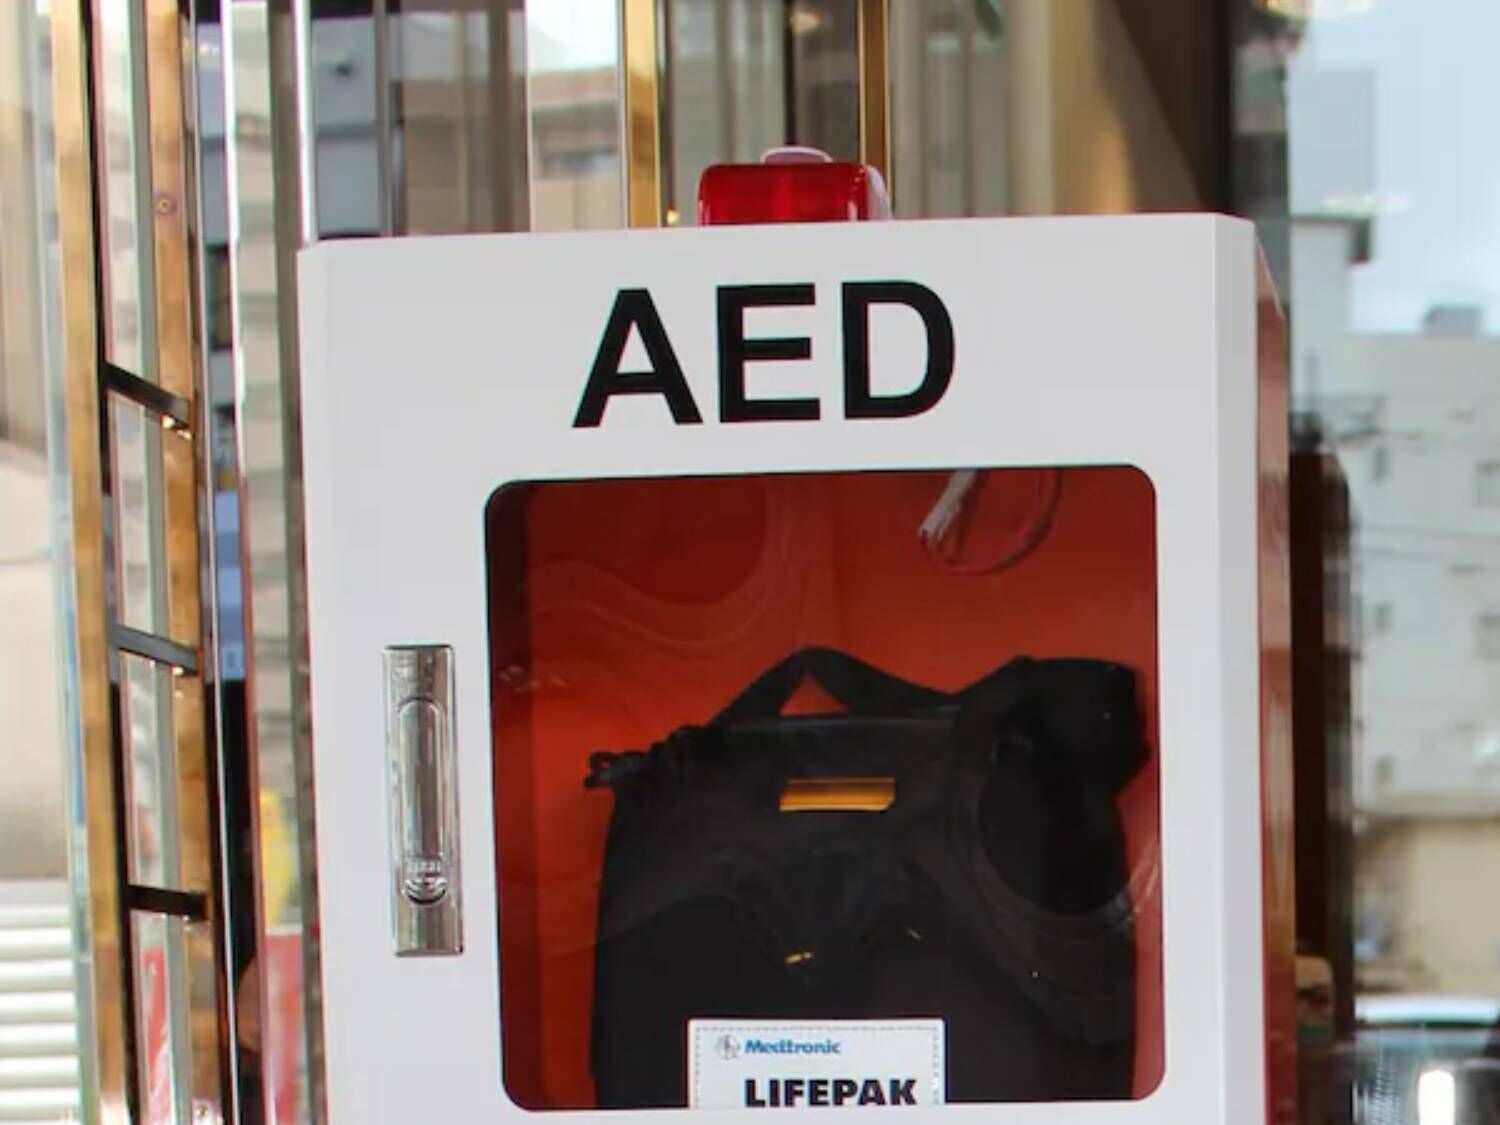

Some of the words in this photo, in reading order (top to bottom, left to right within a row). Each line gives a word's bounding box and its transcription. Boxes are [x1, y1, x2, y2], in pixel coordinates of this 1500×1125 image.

[572, 280, 955, 427] AED
[743, 1039, 842, 1055] Medtronic
[744, 1079, 918, 1108] LIFEPAK
